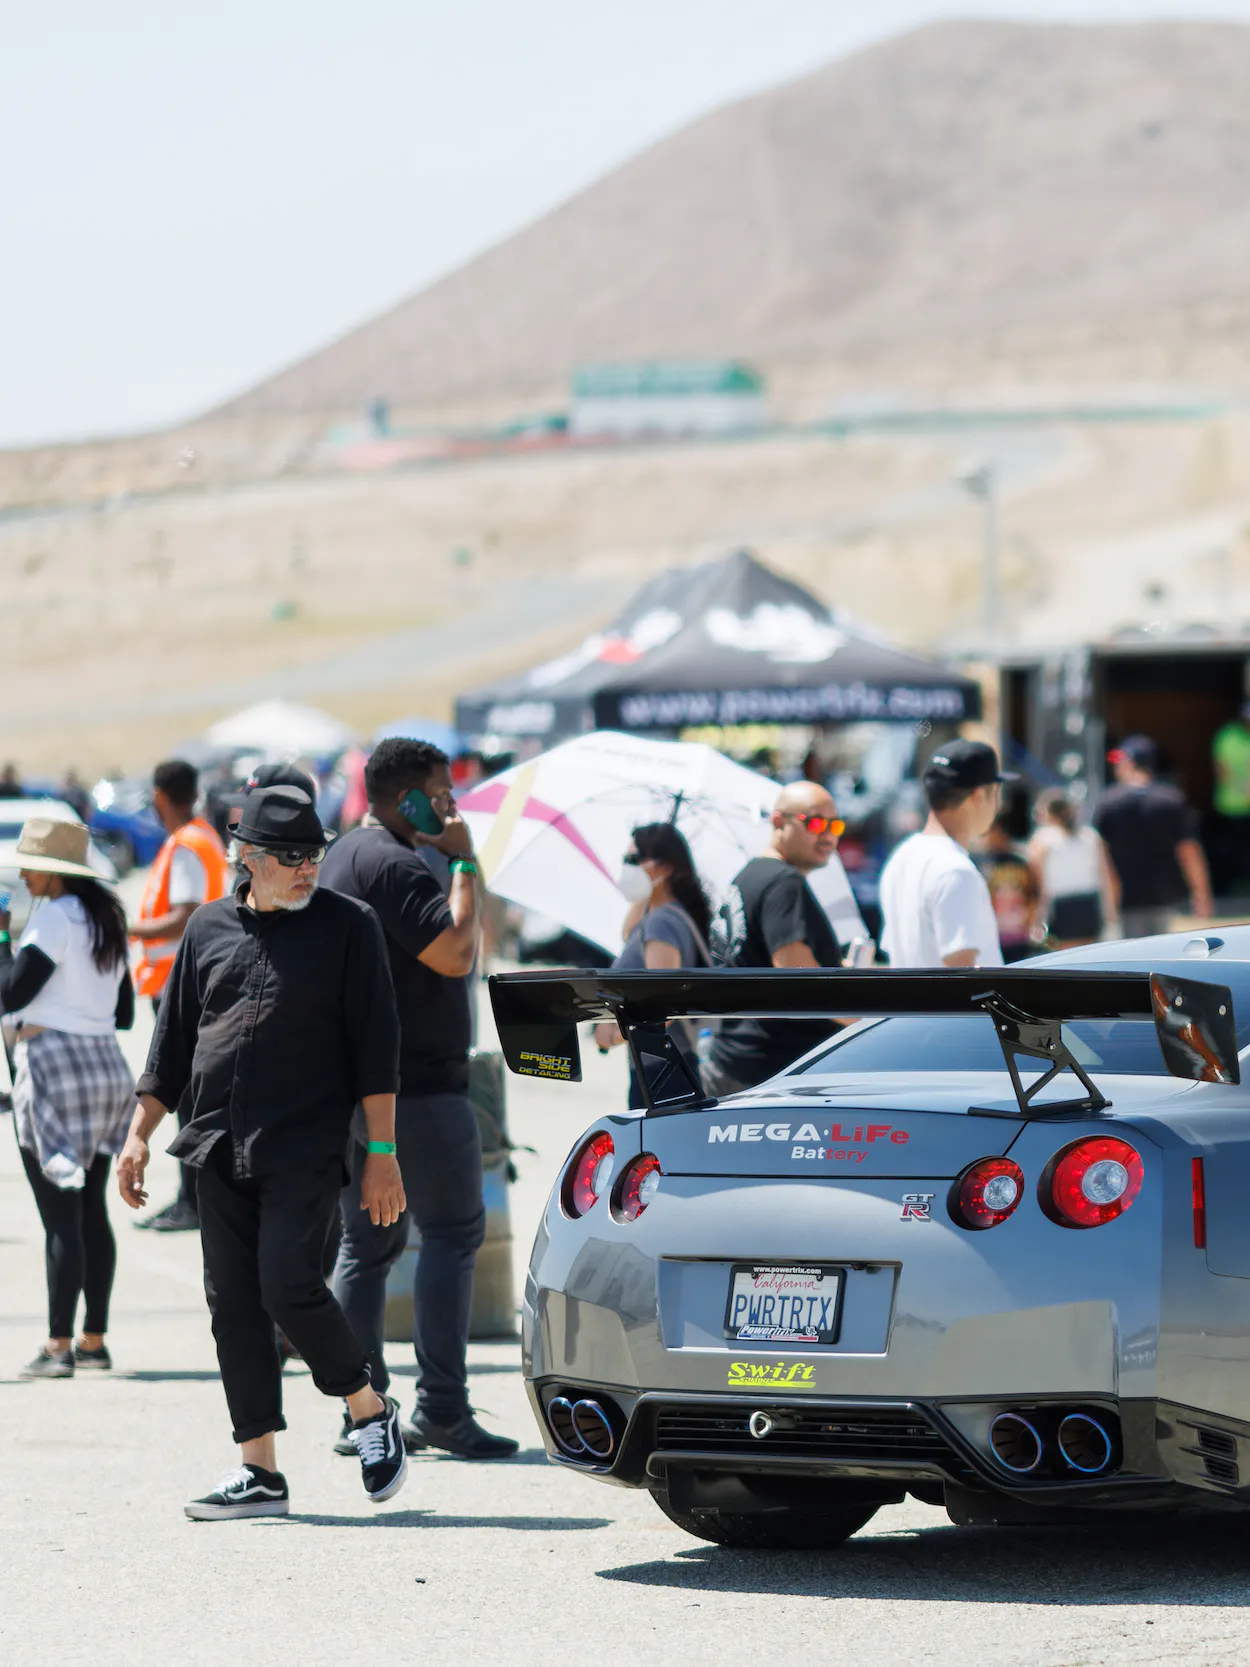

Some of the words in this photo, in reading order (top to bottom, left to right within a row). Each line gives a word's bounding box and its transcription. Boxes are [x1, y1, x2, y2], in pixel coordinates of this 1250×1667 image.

[520, 1052, 571, 1065] BRIGHT
[519, 1067, 571, 1079] DETAILING
[538, 1062, 571, 1073] SIDE
[791, 1146, 868, 1163] Battery
[753, 1266, 822, 1274] www.powertrix.com
[753, 1272, 821, 1294] California
